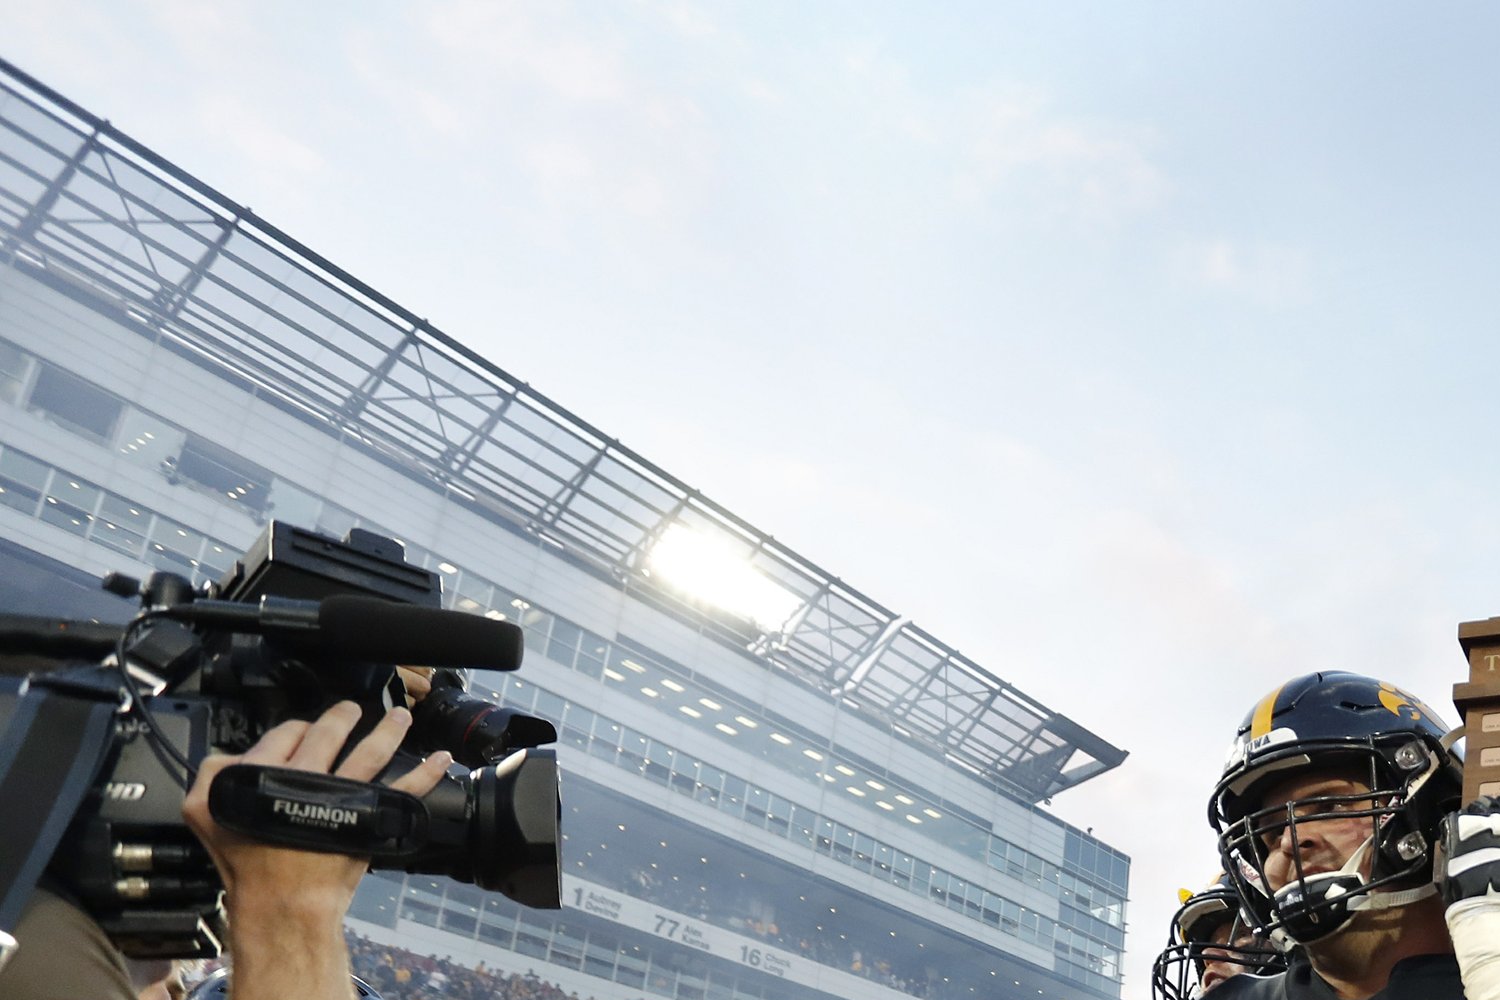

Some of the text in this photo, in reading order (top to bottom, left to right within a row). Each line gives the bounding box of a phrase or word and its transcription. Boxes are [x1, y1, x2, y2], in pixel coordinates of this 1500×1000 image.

[273, 799, 358, 825] FUJINON
[573, 887, 584, 907] 1
[655, 913, 680, 938] 77
[740, 945, 762, 967] 16
